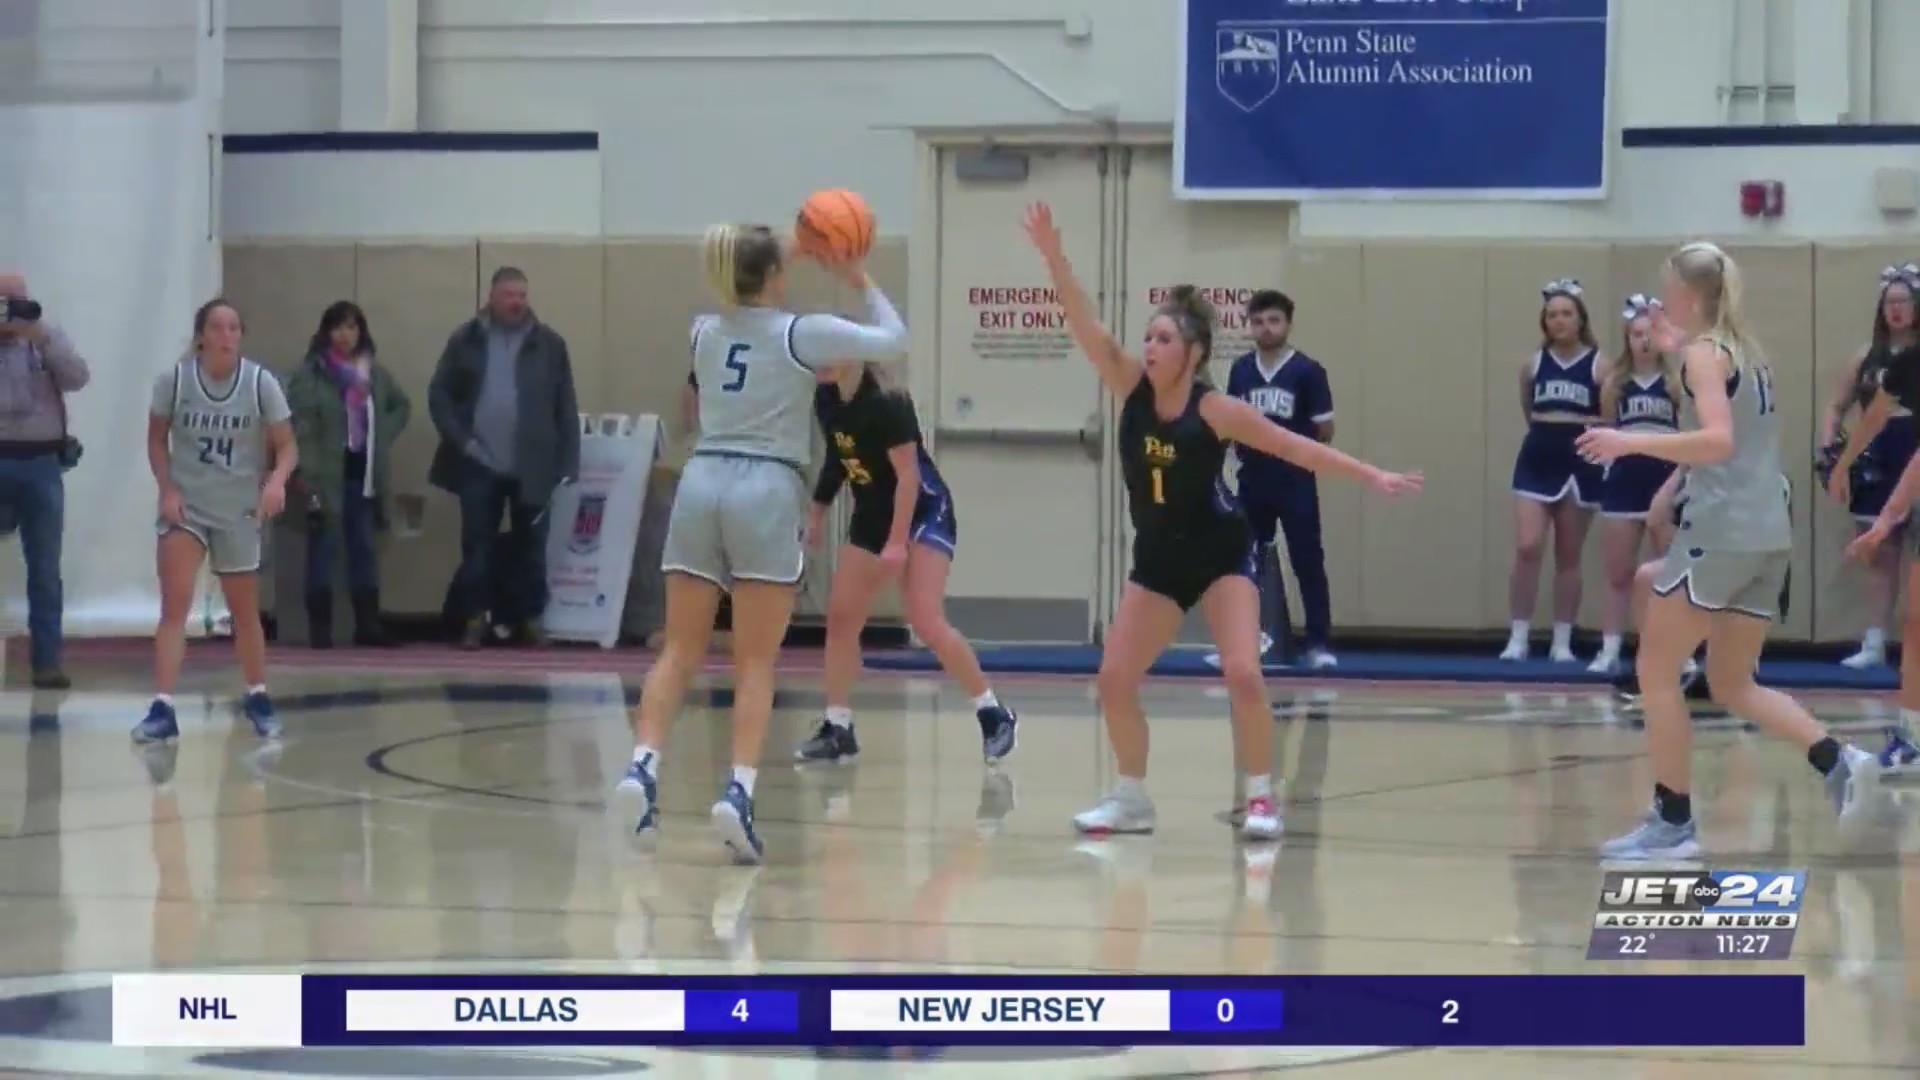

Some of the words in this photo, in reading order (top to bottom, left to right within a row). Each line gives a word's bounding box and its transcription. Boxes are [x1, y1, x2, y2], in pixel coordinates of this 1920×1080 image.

[1288, 31, 1346, 52] Penn
[1357, 31, 1414, 52] State
[1288, 60, 1378, 82] Alumni
[1389, 59, 1531, 82] Association
[968, 287, 1063, 304] EMERGEN
[979, 311, 1016, 328] EXIT
[1021, 311, 1067, 328] ONLY
[722, 343, 751, 392] 5
[198, 436, 233, 466] 24
[1152, 467, 1165, 504] 1
